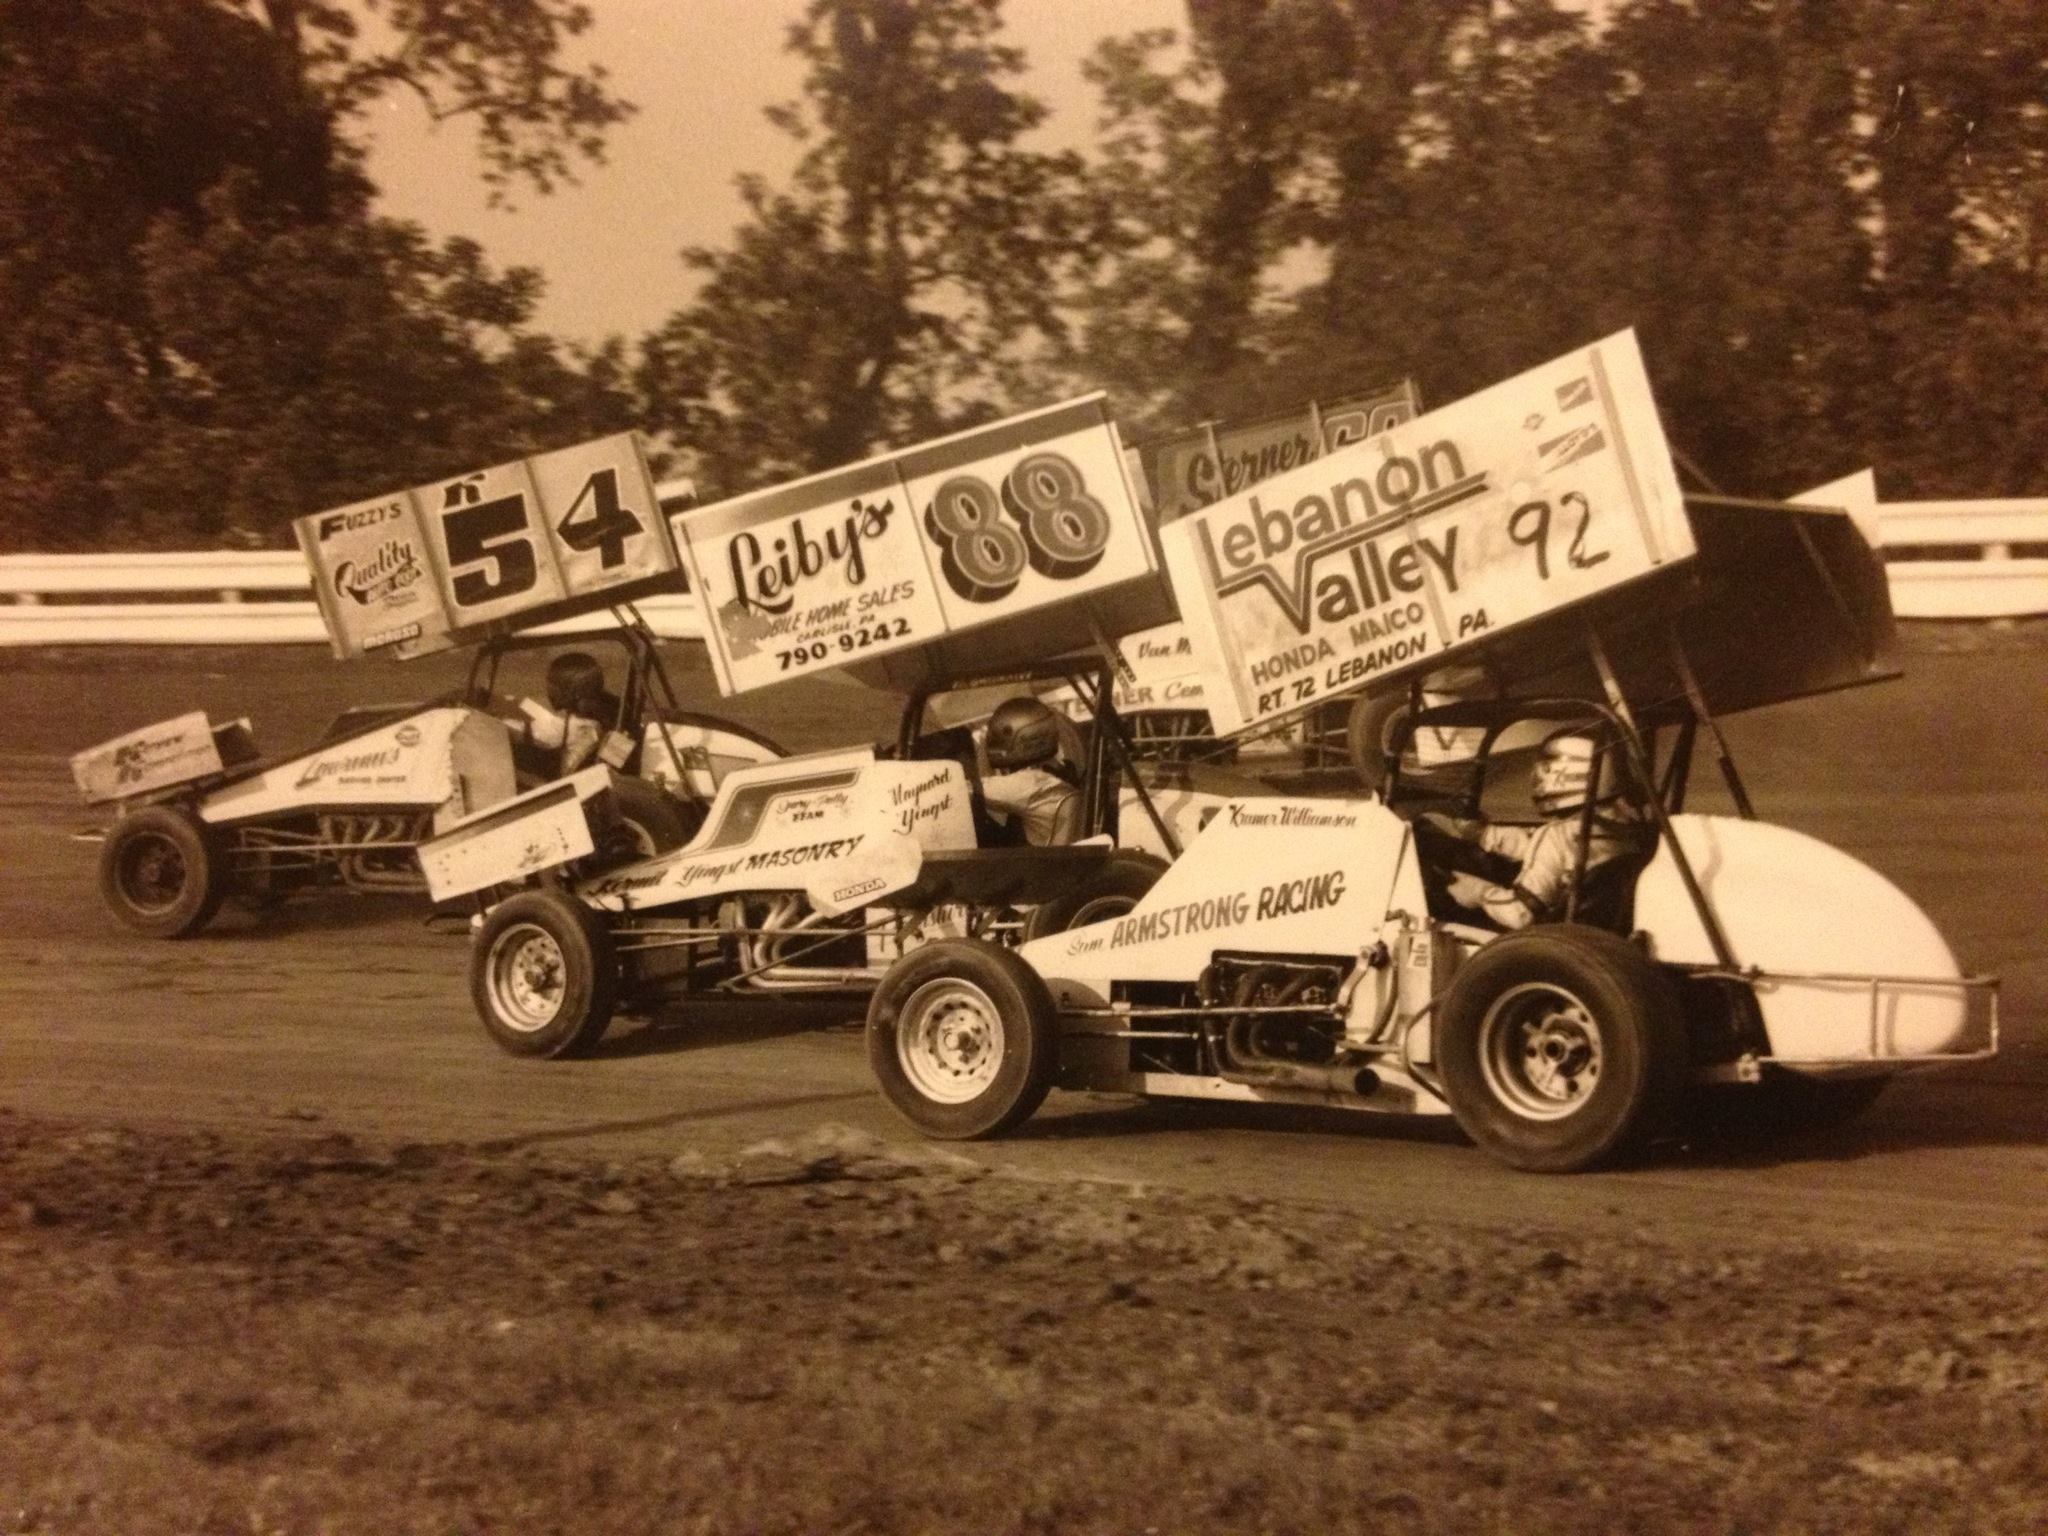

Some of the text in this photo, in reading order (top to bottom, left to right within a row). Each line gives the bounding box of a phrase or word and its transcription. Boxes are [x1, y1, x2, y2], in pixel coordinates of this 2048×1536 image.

[442, 468, 645, 607] 54
[924, 451, 1111, 604] 88
[1196, 440, 1467, 588] Lebanon
[1507, 491, 1610, 580] 92
[335, 540, 418, 600] Quality
[729, 498, 895, 615] Leiby's
[1262, 525, 1459, 636] Valley
[775, 617, 912, 670] 790-9242
[805, 598, 851, 626] HOME
[857, 580, 915, 612] SALES
[1251, 602, 1425, 686] HONDA MAICO
[1292, 677, 1316, 701] 72
[1325, 632, 1427, 689] LEBANON
[745, 834, 866, 872] MASONRY
[833, 878, 888, 902] HONDA
[1110, 892, 1251, 949] ARMSTRONG
[1256, 870, 1347, 921] RACING
